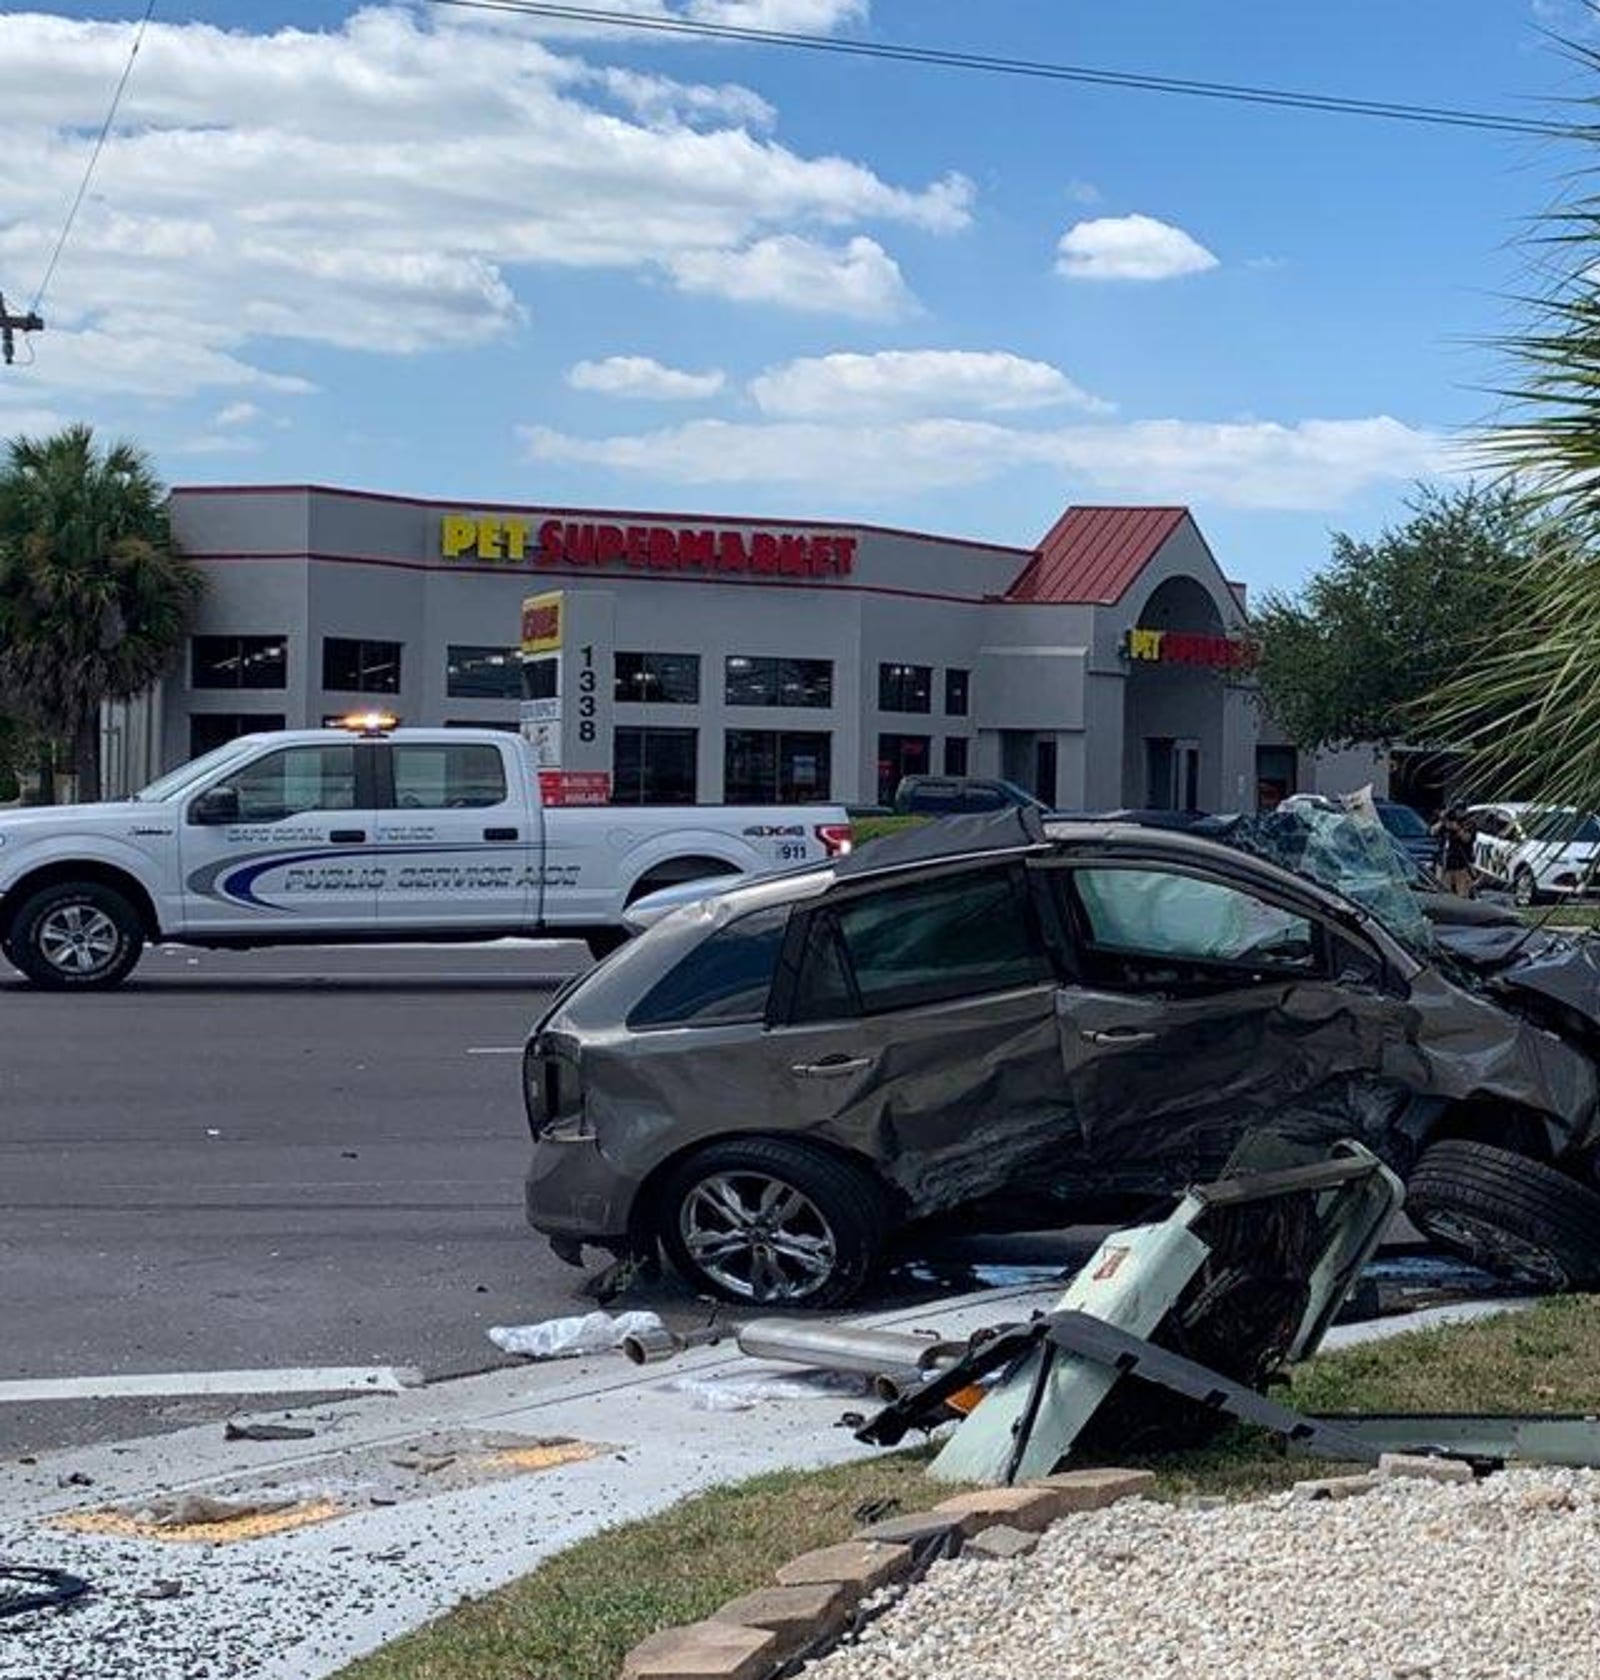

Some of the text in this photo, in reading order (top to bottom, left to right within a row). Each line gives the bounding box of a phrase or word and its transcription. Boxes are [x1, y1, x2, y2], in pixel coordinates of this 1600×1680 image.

[441, 513, 858, 577] PET SUPERMARKET
[579, 645, 597, 742] 1338
[782, 844, 806, 859] 911
